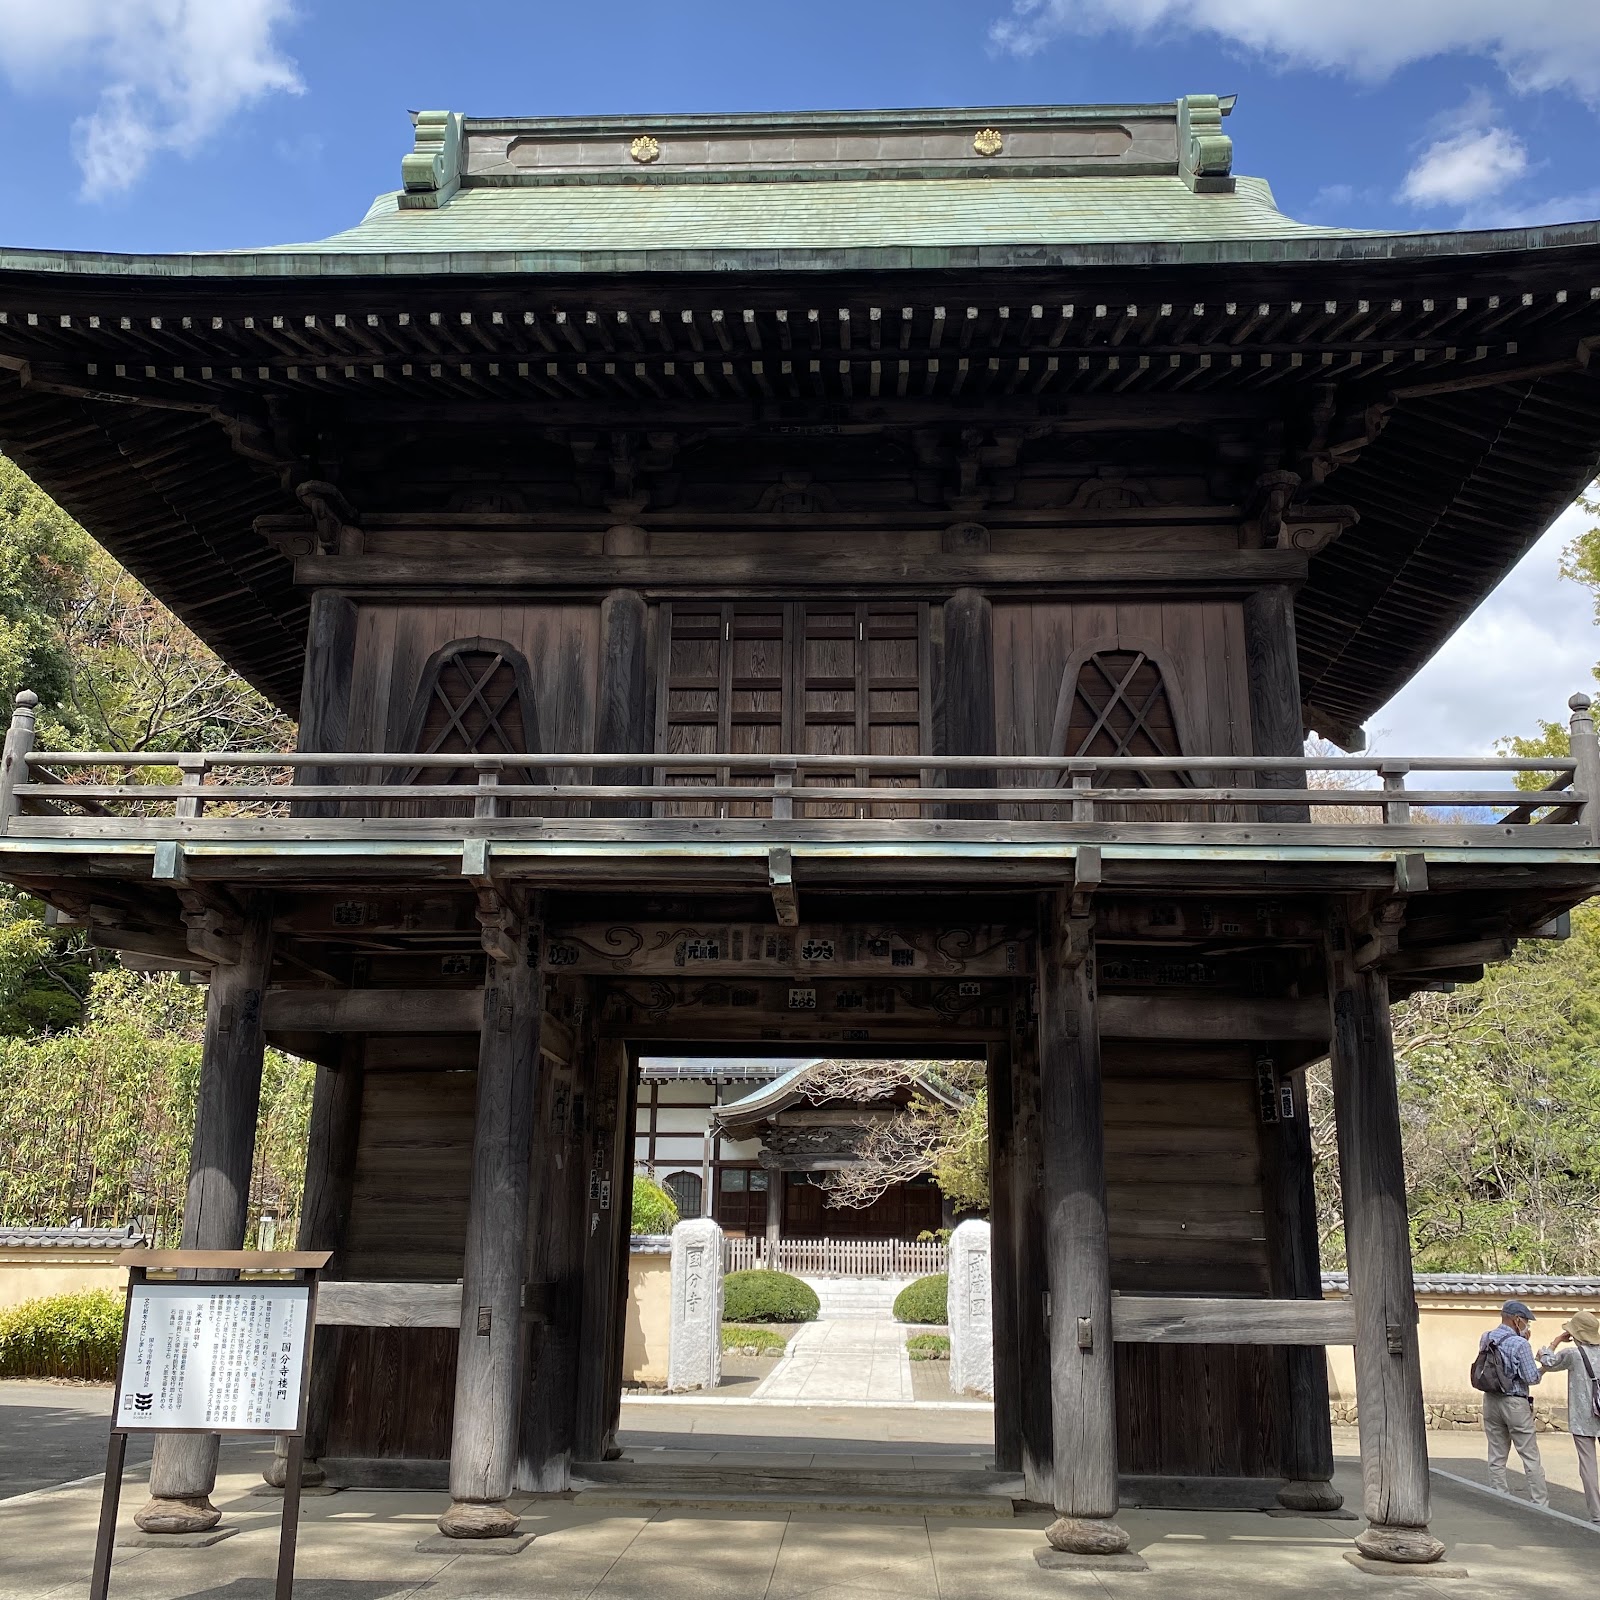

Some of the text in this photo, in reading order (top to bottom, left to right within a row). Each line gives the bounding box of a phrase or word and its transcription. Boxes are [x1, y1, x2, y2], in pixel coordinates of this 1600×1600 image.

[276, 1342, 291, 1400] 国分寺楼門
